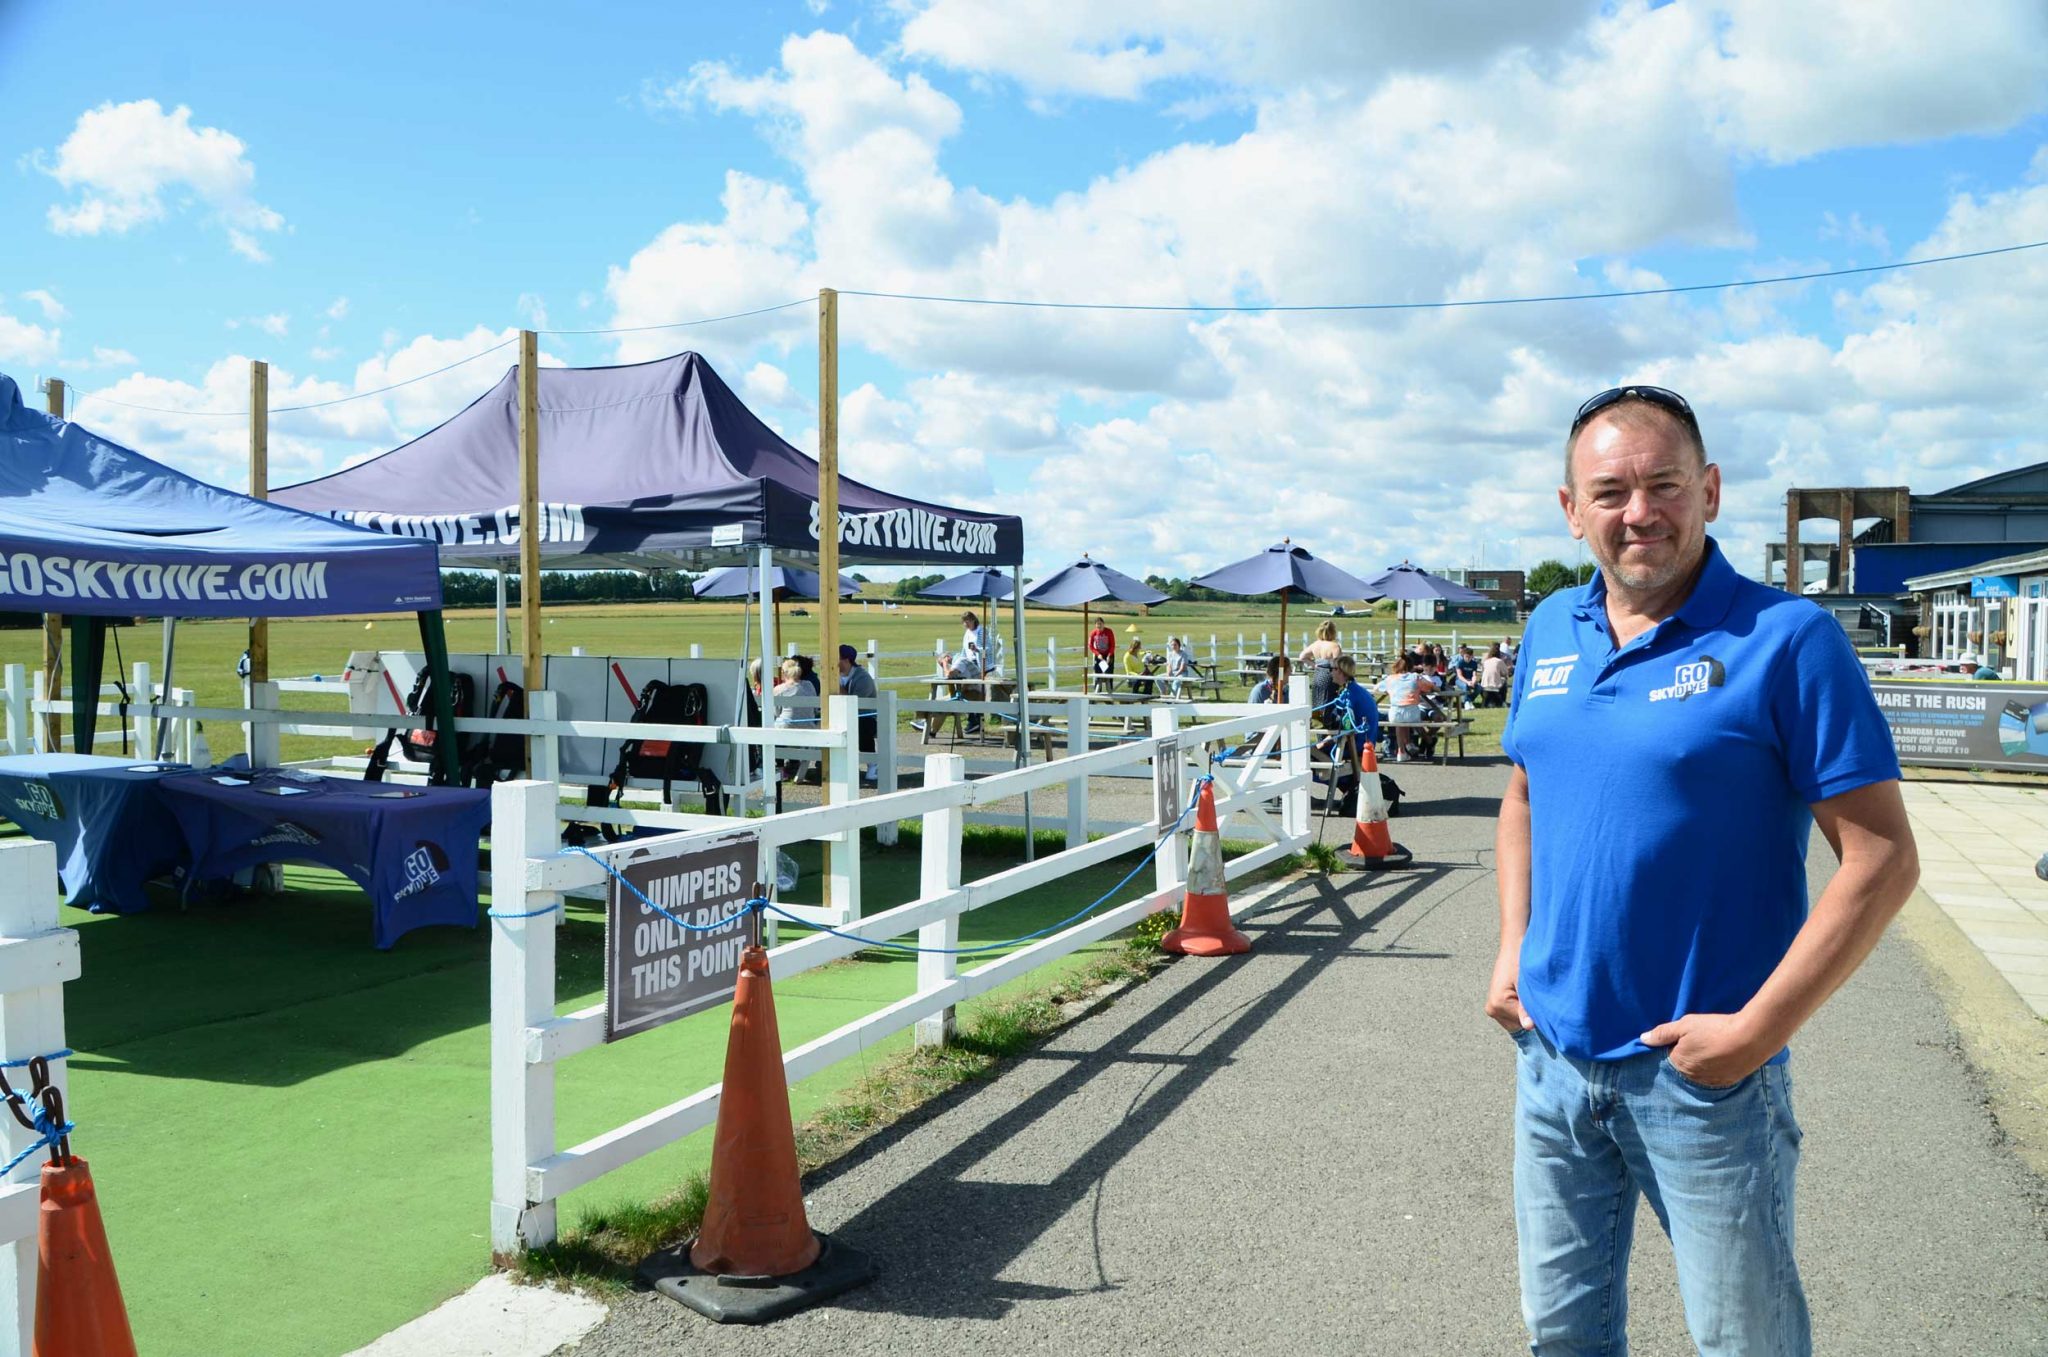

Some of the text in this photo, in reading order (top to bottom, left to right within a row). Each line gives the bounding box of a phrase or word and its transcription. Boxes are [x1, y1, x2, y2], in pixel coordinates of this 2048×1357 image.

[336, 503, 584, 546] KYDIVE.CM
[1531, 664, 1574, 689] PILOT
[1677, 663, 1708, 684] GO
[1648, 681, 1708, 702] SKYDIVE
[1874, 693, 1986, 711] HARE THE RUSH
[1892, 735, 1958, 746] EPOSIT GIFT CARD
[1902, 727, 1933, 736] TANDEM
[1934, 728, 1967, 737] SKYDIVE
[1917, 744, 1933, 753] FOR
[1934, 745, 1954, 754] JUST
[404, 849, 431, 881] GO
[640, 861, 742, 916] JUMPERS
[634, 898, 747, 958] ONLY PAST
[631, 935, 747, 999] THIS POINT
